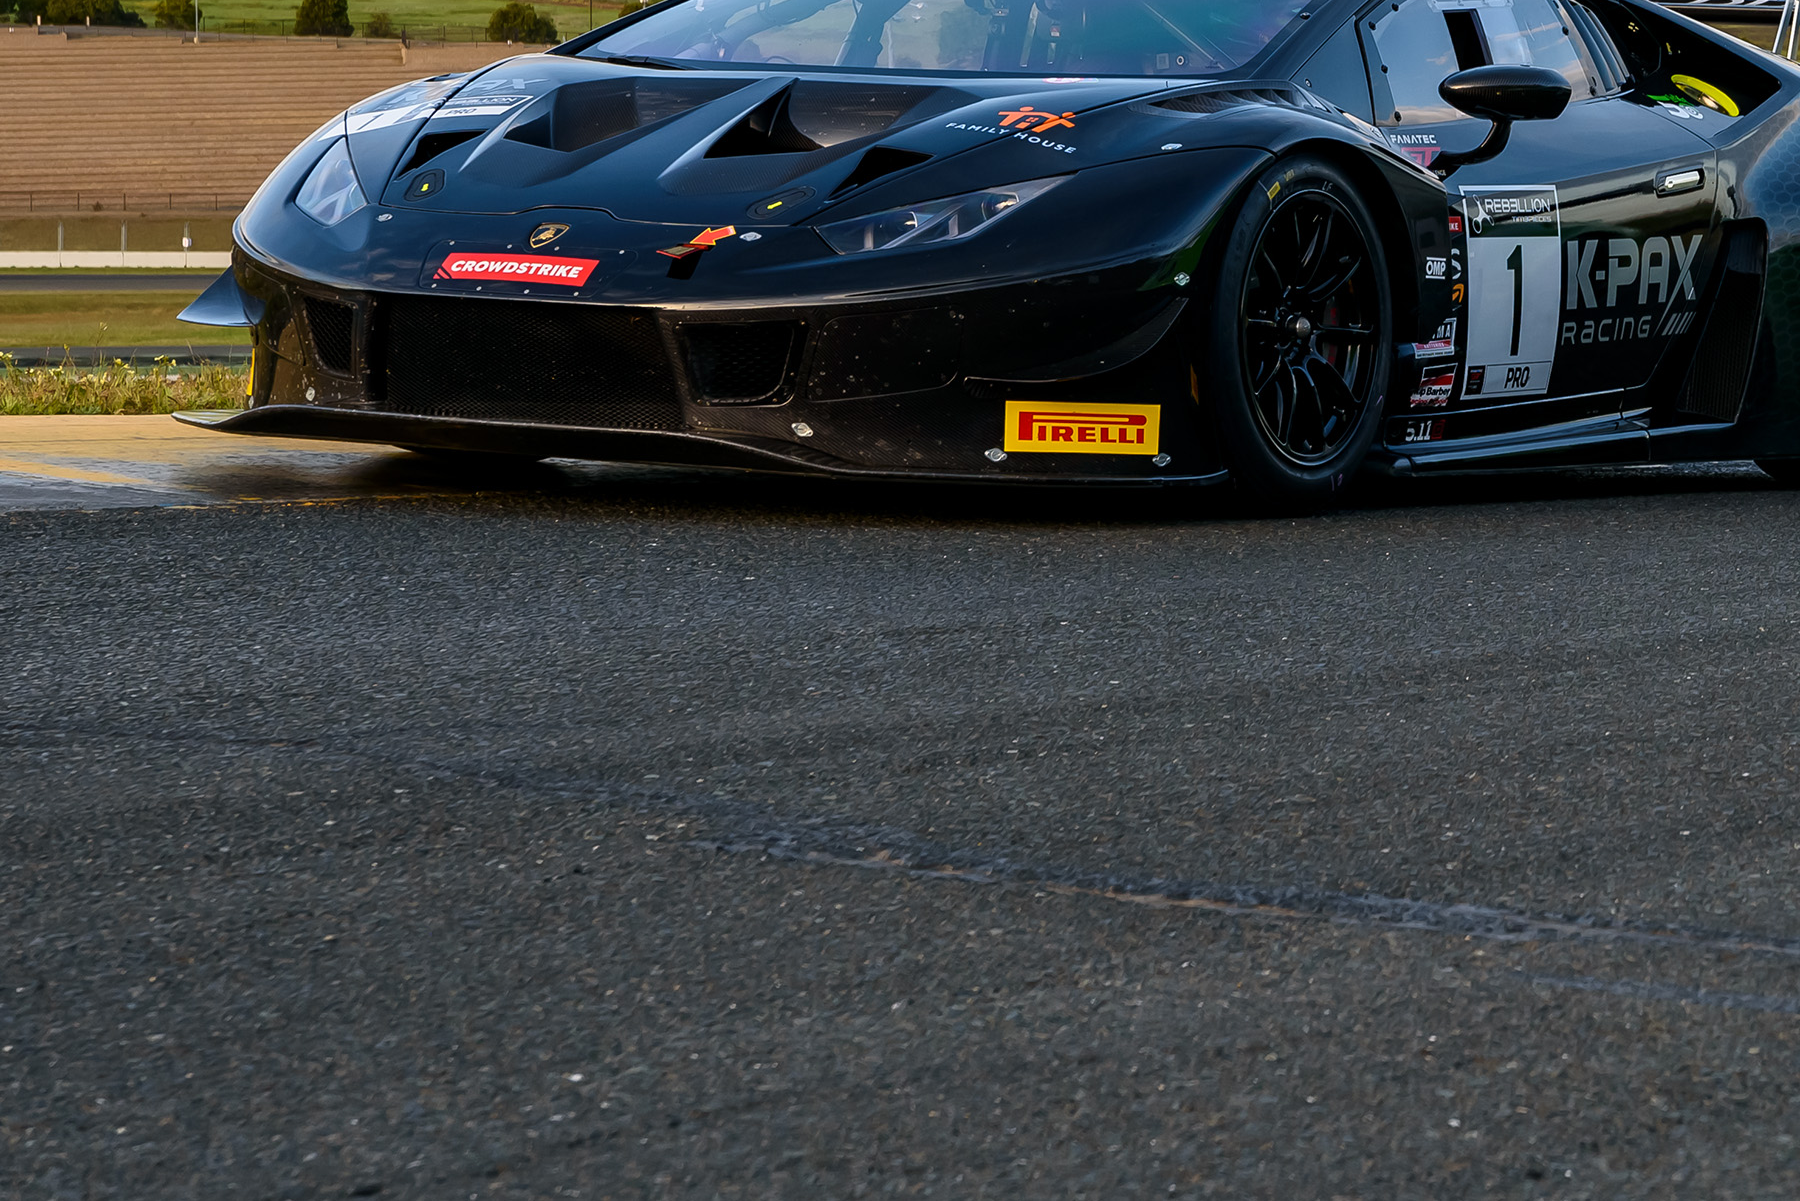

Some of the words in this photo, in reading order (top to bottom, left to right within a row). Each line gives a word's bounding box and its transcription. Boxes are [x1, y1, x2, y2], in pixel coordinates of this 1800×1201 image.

[445, 108, 477, 116] PRO
[945, 123, 1010, 135] FAMILY
[1014, 132, 1077, 154] HOUSE
[1390, 134, 1437, 144] FANATEC
[1485, 199, 1550, 213] REBELLION
[450, 260, 583, 278] CROWDSTRIKE
[1425, 260, 1446, 276] OMP
[1567, 235, 1703, 310] K-PAX
[1506, 244, 1523, 356] 1
[1504, 366, 1530, 389] PRO
[1018, 411, 1148, 444] PIRELLI
